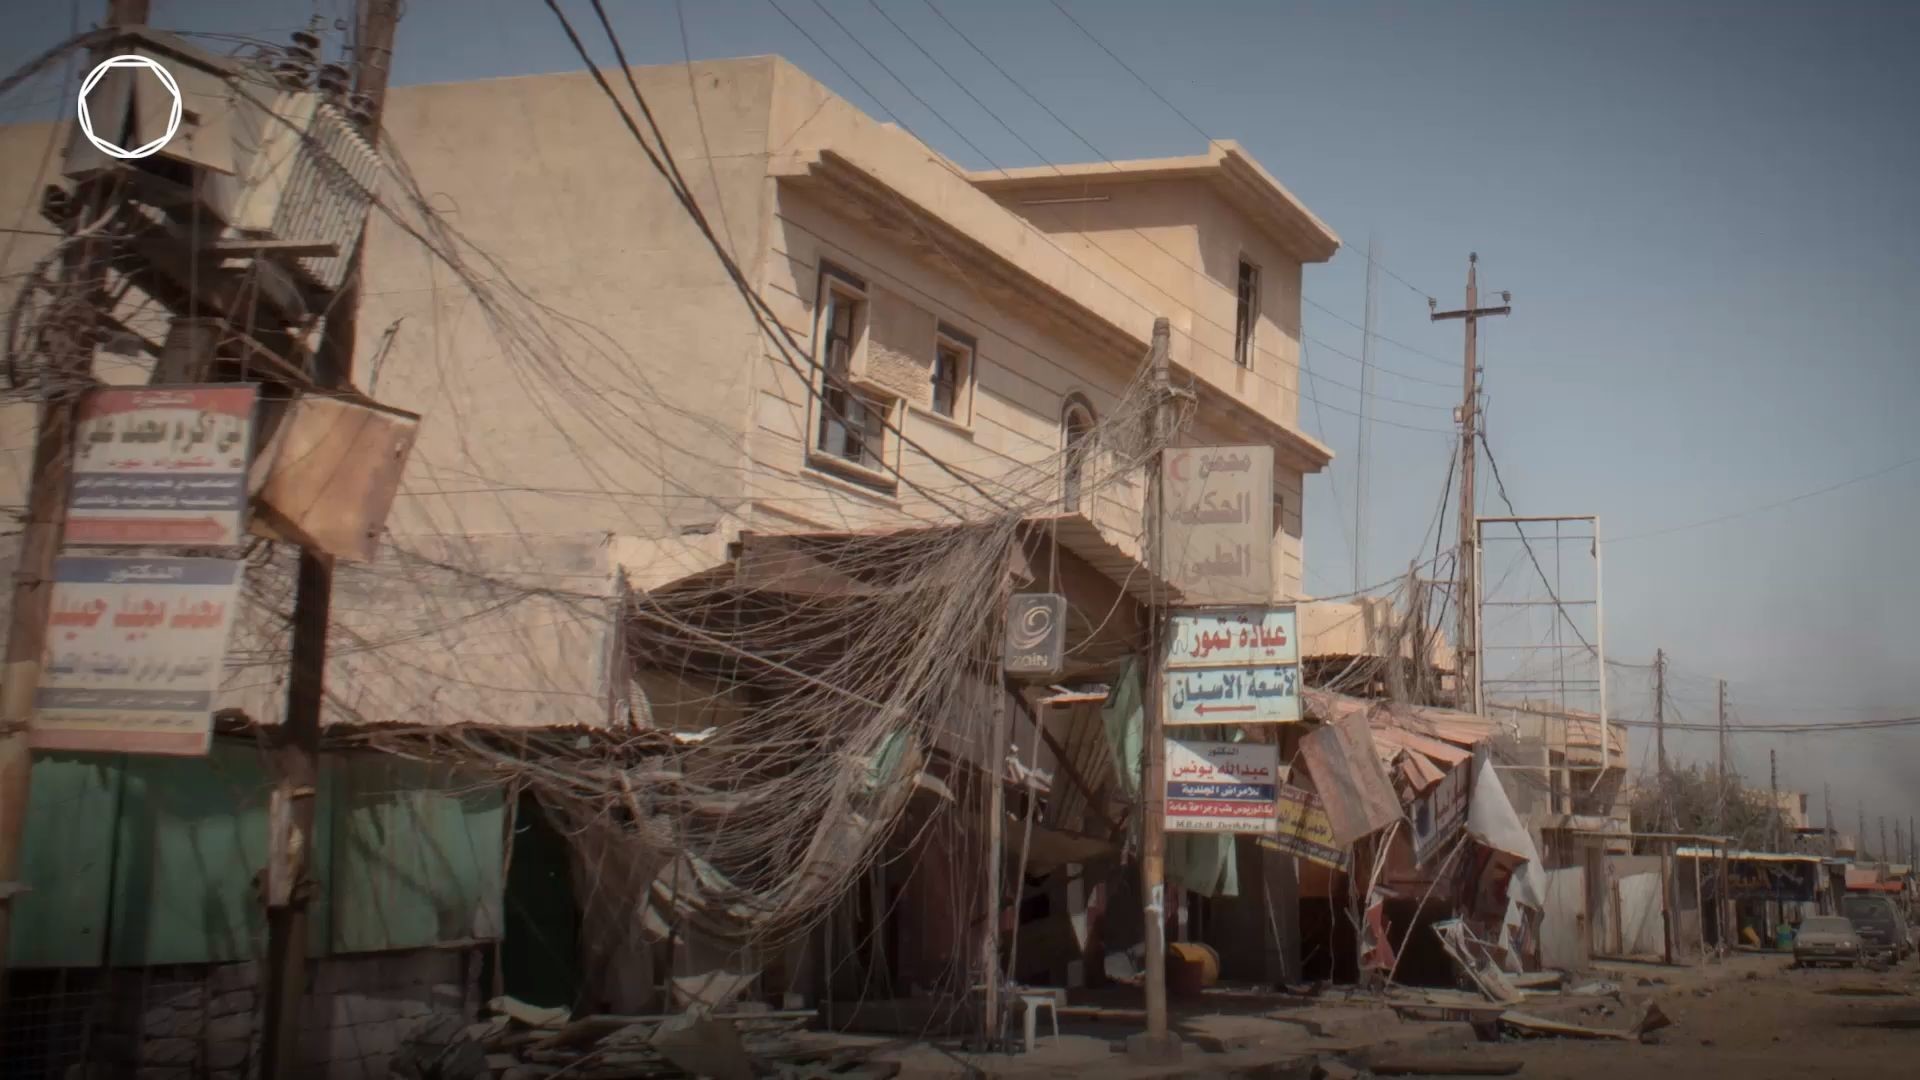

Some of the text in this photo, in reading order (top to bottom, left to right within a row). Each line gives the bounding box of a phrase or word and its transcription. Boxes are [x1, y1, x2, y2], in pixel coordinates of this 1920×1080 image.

[1198, 453, 1252, 479] مجمع
[1190, 616, 1287, 658] عيادة تموز
[1208, 746, 1240, 757] الدكتور
[1172, 760, 1214, 779] يونس
